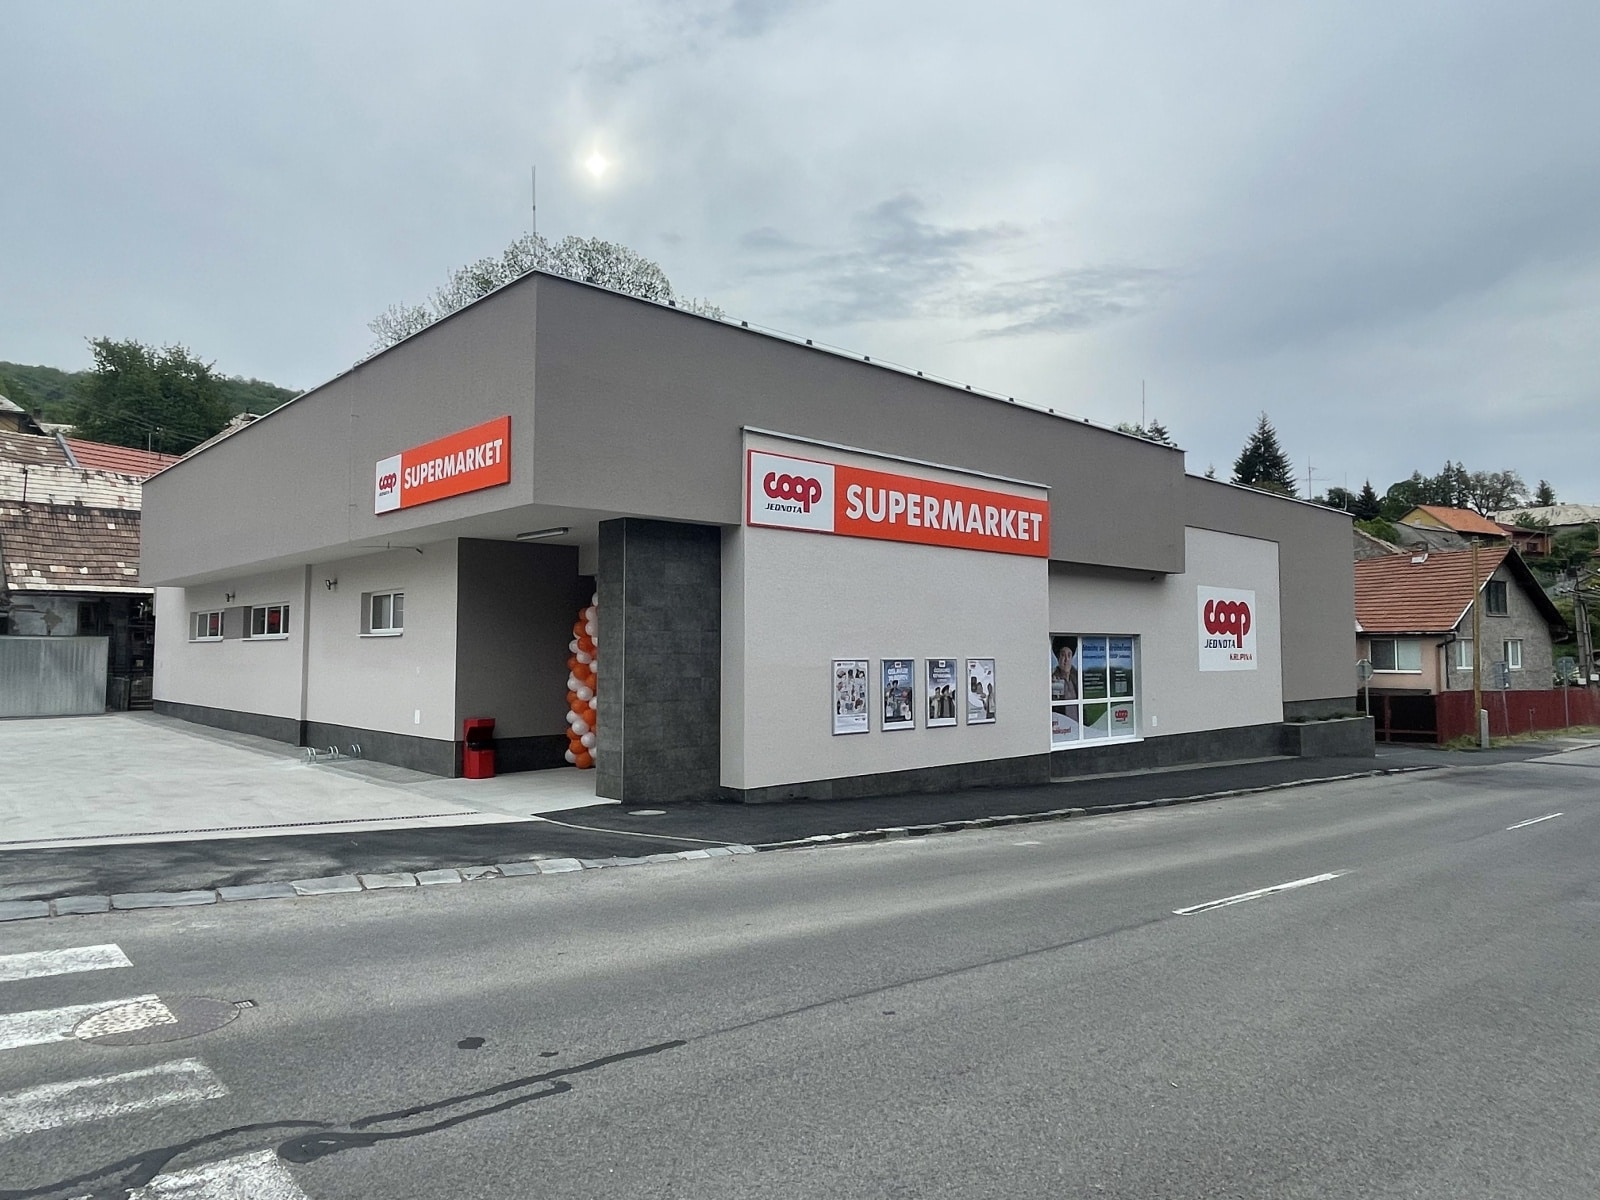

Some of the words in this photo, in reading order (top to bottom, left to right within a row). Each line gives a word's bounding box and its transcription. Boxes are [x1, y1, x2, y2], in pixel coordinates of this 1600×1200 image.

[378, 472, 397, 493] coop
[404, 438, 503, 490] SUPERMARKET
[763, 471, 822, 513] coop
[764, 502, 803, 514] JEDNOTA
[845, 483, 1043, 542] SUPERMARKET
[1203, 599, 1251, 648] coop
[1204, 639, 1236, 648] JEDNOTA
